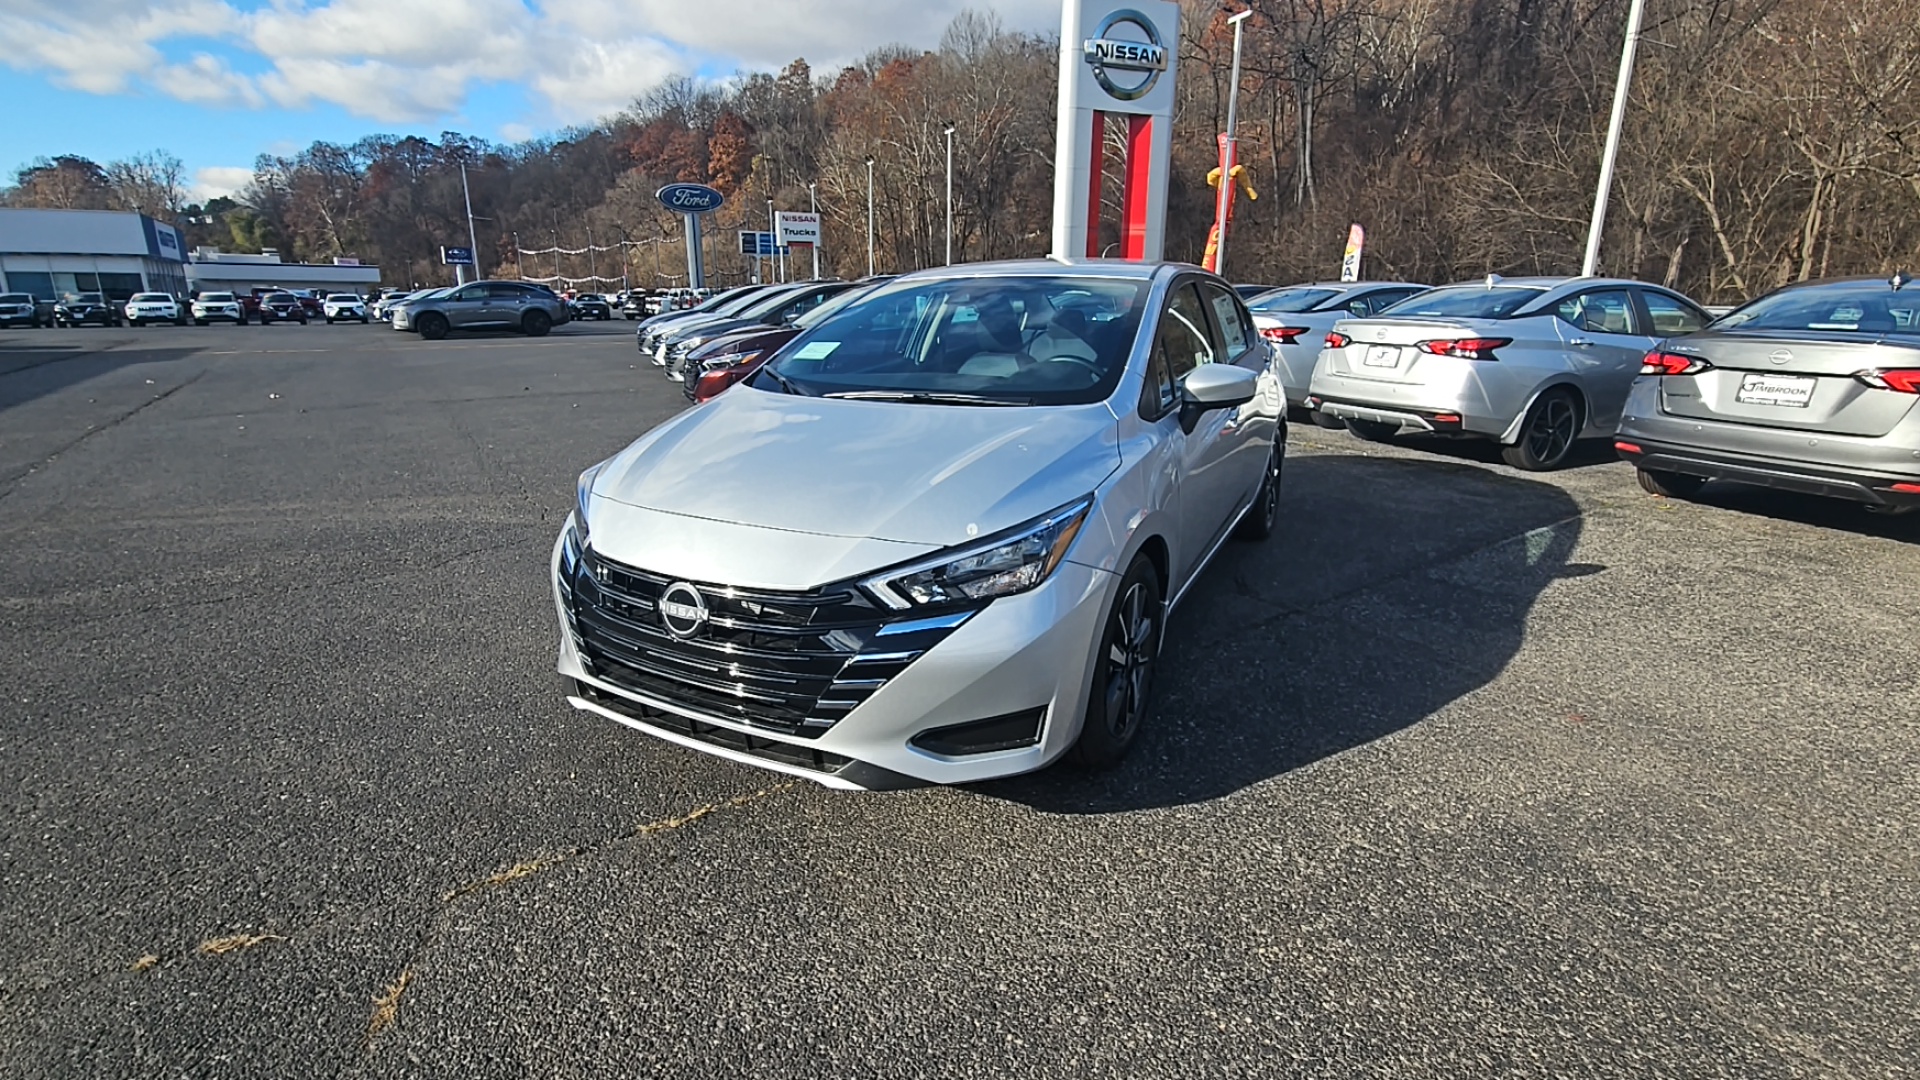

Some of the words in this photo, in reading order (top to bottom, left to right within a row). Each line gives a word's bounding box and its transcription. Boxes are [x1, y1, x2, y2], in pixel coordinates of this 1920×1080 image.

[1095, 43, 1162, 65] NISSAN
[672, 188, 710, 206] Ford
[782, 214, 817, 223] NISSAN
[783, 227, 816, 236] Trucks
[658, 599, 709, 621] NISSAN
